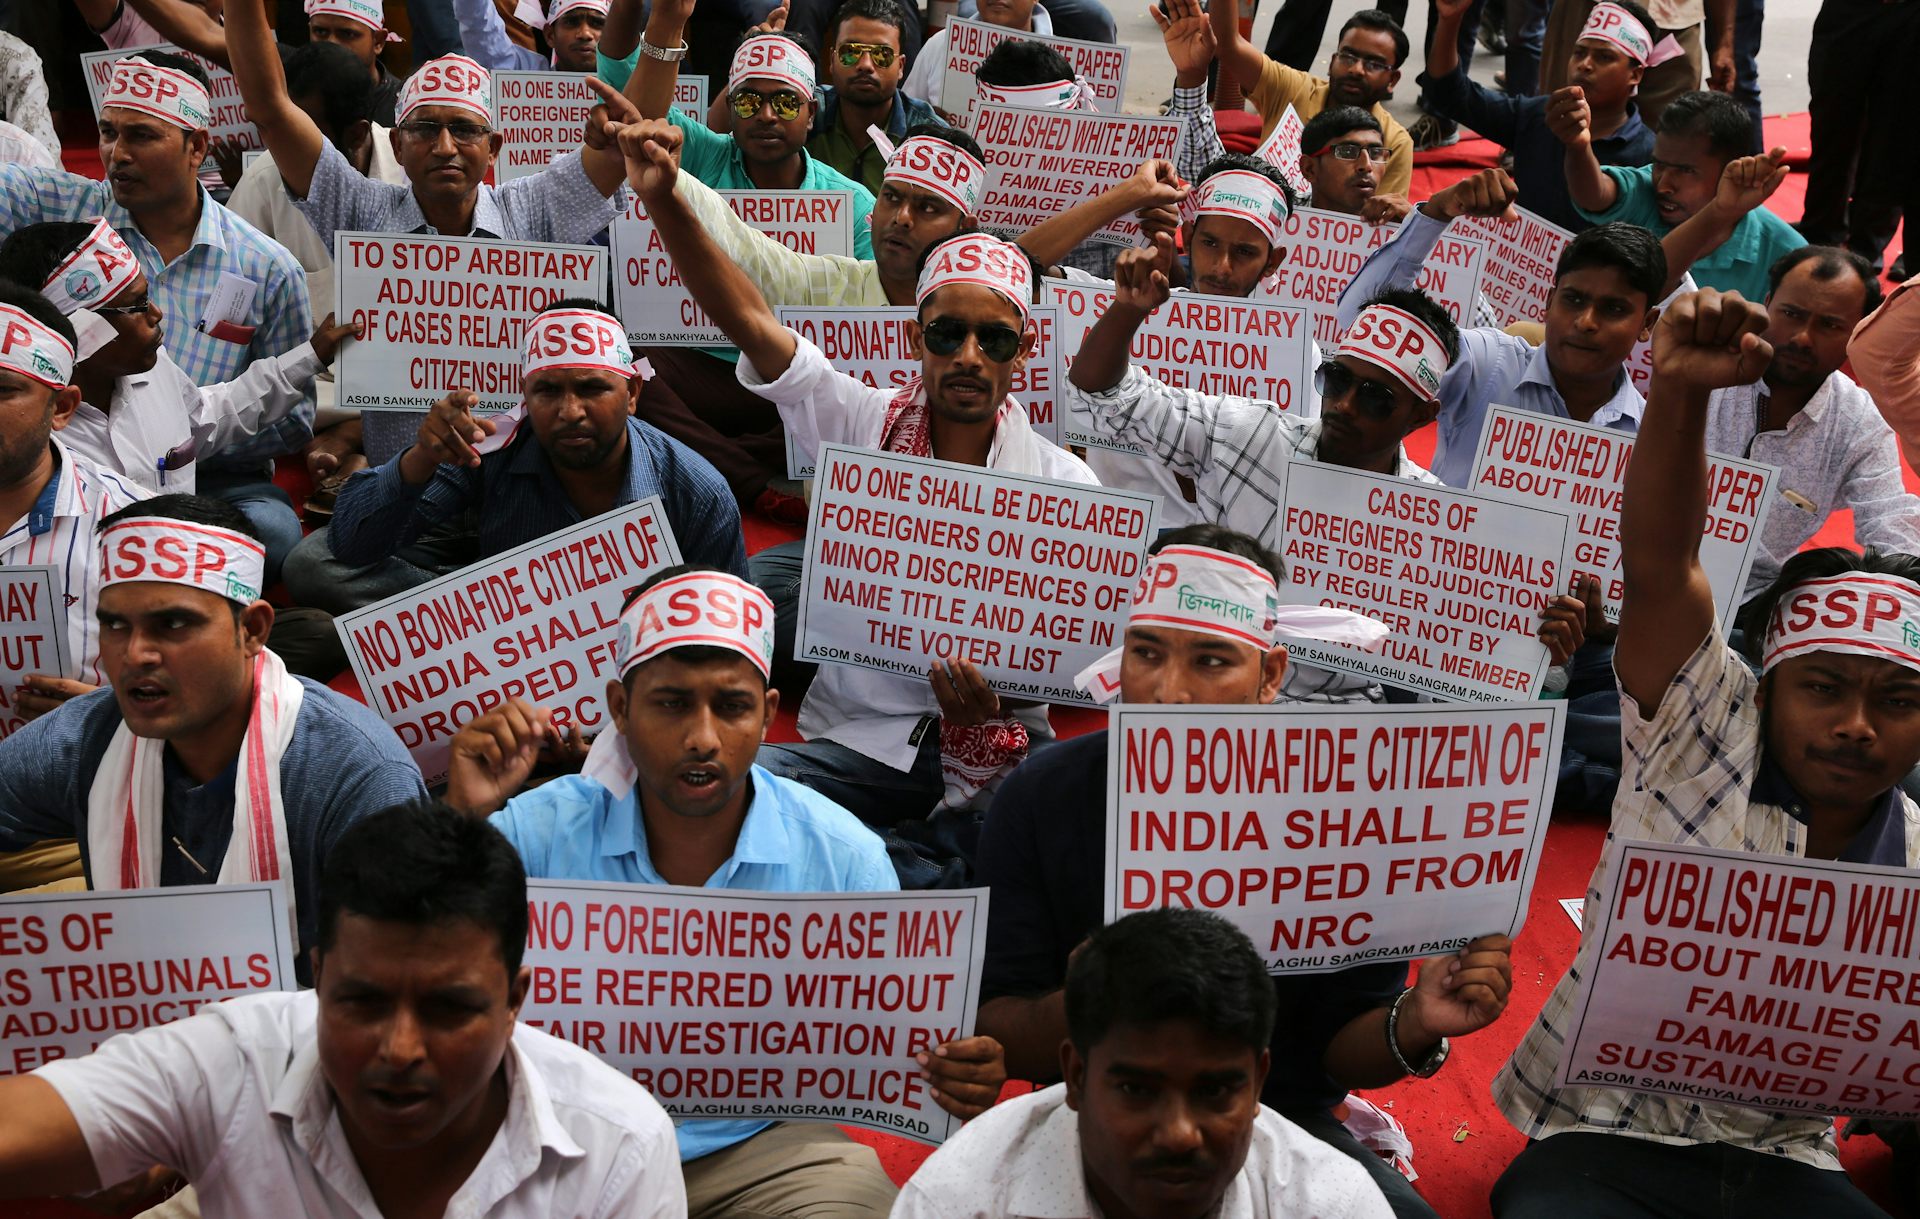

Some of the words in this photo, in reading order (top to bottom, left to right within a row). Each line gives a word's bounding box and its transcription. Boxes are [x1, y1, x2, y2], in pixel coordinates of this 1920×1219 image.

[404, 65, 481, 103] ASSP
[948, 57, 982, 76] ABO
[1075, 47, 1122, 81] PAPER
[103, 69, 179, 104] SSP
[502, 81, 521, 98] NO
[525, 82, 553, 99] ONE
[558, 82, 597, 100] SHAL
[500, 106, 591, 122] FOREIGNER
[976, 110, 1071, 151] PUBLISHED
[1071, 119, 1126, 154] WHITE
[1126, 123, 1178, 160] PAPER
[503, 127, 553, 144] MINOR
[509, 150, 552, 166] NAME
[889, 145, 971, 187] ASSP
[985, 149, 1035, 169] BOUT
[984, 191, 1065, 212] DAMAGE
[1000, 173, 1084, 195] FAMILIES
[729, 198, 841, 223] ARBITARY
[976, 208, 1052, 227] STAINE
[1306, 216, 1363, 246] STOP
[1094, 233, 1133, 244] PARISAD
[1520, 220, 1562, 263] WHITE
[349, 241, 384, 269] TO
[392, 242, 460, 272] STOP
[467, 247, 595, 281] ARBITARY
[627, 257, 650, 287] OF
[929, 245, 1026, 286] ASSP
[1484, 259, 1527, 290] MILIES
[377, 278, 565, 313] ADJUDICATION
[1053, 288, 1085, 316] TO
[1166, 302, 1300, 339] ARBITARY
[352, 308, 379, 341] OF
[385, 310, 452, 346] CASES
[459, 314, 527, 350] RELATI
[528, 322, 615, 364] ASSP
[627, 333, 657, 341] ASOM
[659, 333, 731, 342] SANKHYALAG
[1345, 312, 1425, 360] SSP
[410, 357, 524, 394] CITIZENSHI
[1264, 378, 1291, 410] TO
[346, 395, 380, 405] ASOM
[1065, 431, 1087, 442] SOM
[1480, 464, 1566, 500] ABOUT
[1487, 416, 1612, 480] PUBLISHED
[1705, 463, 1764, 517] APER
[830, 460, 862, 494] NO
[867, 467, 912, 502] ONE
[918, 475, 985, 515] SHALL
[992, 487, 1023, 520] BE
[1027, 493, 1145, 540] DECLARED
[1368, 487, 1440, 527] CASES
[1446, 502, 1479, 534] OF
[821, 502, 980, 552] FOREIGNERS
[987, 530, 1024, 560] ON
[1030, 540, 1138, 579] GROUND
[1286, 507, 1422, 559] FOREIGNERS
[1430, 535, 1555, 588] TRIBUNALS
[354, 619, 401, 676] NO
[397, 566, 533, 659] BONAFIDE
[528, 532, 623, 605] CITIZEN
[624, 515, 660, 569] OF
[820, 539, 900, 577] MINOR
[906, 553, 1087, 608] DISCRIPENCES
[1095, 584, 1130, 612] OF
[1286, 539, 1329, 565] ARE
[1336, 548, 1393, 578] TOBE
[1399, 562, 1549, 611] ADJUDICTION
[0, 582, 38, 622] AY
[635, 588, 764, 648] ASSP
[823, 577, 893, 612] NAME
[900, 588, 964, 625] TITLE
[971, 602, 1024, 635] AND
[1030, 612, 1083, 644] AGE
[1092, 621, 1115, 648] IN
[1292, 565, 1321, 588] BY
[1325, 572, 1429, 613] REGULER
[1434, 598, 1537, 638] JUDICIAL
[381, 651, 490, 713] INDIA
[493, 601, 618, 668] SHALL
[867, 619, 912, 652] THE
[920, 630, 1001, 667] VOTER
[1008, 645, 1062, 674] LIST
[1417, 620, 1460, 646] NOT
[1469, 630, 1500, 656] BY
[809, 645, 850, 661] ASOM
[1043, 686, 1094, 701] PARISA
[1309, 649, 1406, 681] SANKHYALAGHU
[1408, 675, 1468, 699] SANGRAM
[1470, 689, 1515, 702] PARISA
[1440, 652, 1531, 693] MEMBER
[552, 695, 602, 737] RC
[1126, 727, 1174, 795] NO
[1185, 726, 1358, 795] BONAFIDE
[1367, 724, 1492, 793] CITIZEN
[1499, 722, 1546, 786] OF
[1129, 810, 1269, 852] INDIA
[1284, 804, 1447, 850] SHALL
[1463, 798, 1530, 839] BE
[1123, 861, 1370, 910] DROPPED
[1385, 848, 1524, 896] FROM
[528, 900, 574, 951] NO
[584, 903, 791, 960] FOREIGNERS
[802, 911, 887, 960] CASE
[896, 909, 963, 958] MAY
[1616, 857, 1837, 948] PUBLISHED
[1844, 882, 1920, 961] WHI
[61, 912, 113, 952] OF
[1270, 911, 1374, 953] NRC
[1329, 945, 1416, 967] SANGRAM
[1419, 936, 1479, 953] PARISA
[41, 953, 272, 1004] TRIBUNALS
[533, 966, 582, 1005] BE
[596, 969, 772, 1008] REFRRED
[785, 973, 954, 1012] WITHOUT
[1607, 933, 1761, 981] ABOUT
[1769, 955, 1920, 1006] MIVERE
[1685, 985, 1882, 1043] FAMILIES
[619, 1021, 895, 1059] INVESTIGATION
[907, 1027, 957, 1058] BY
[1655, 1018, 1844, 1073] DAMAGE
[632, 1068, 783, 1098] BORDER
[796, 1067, 923, 1110] POLICE
[1576, 1068, 1637, 1086] ASOM
[1640, 1076, 1809, 1109] SANKHYALAGHU
[1596, 1042, 1829, 1098] SUSTAINED
[1838, 1083, 1904, 1107] BY
[750, 1103, 844, 1117] SANGRAM
[851, 1106, 930, 1137] PARISAD
